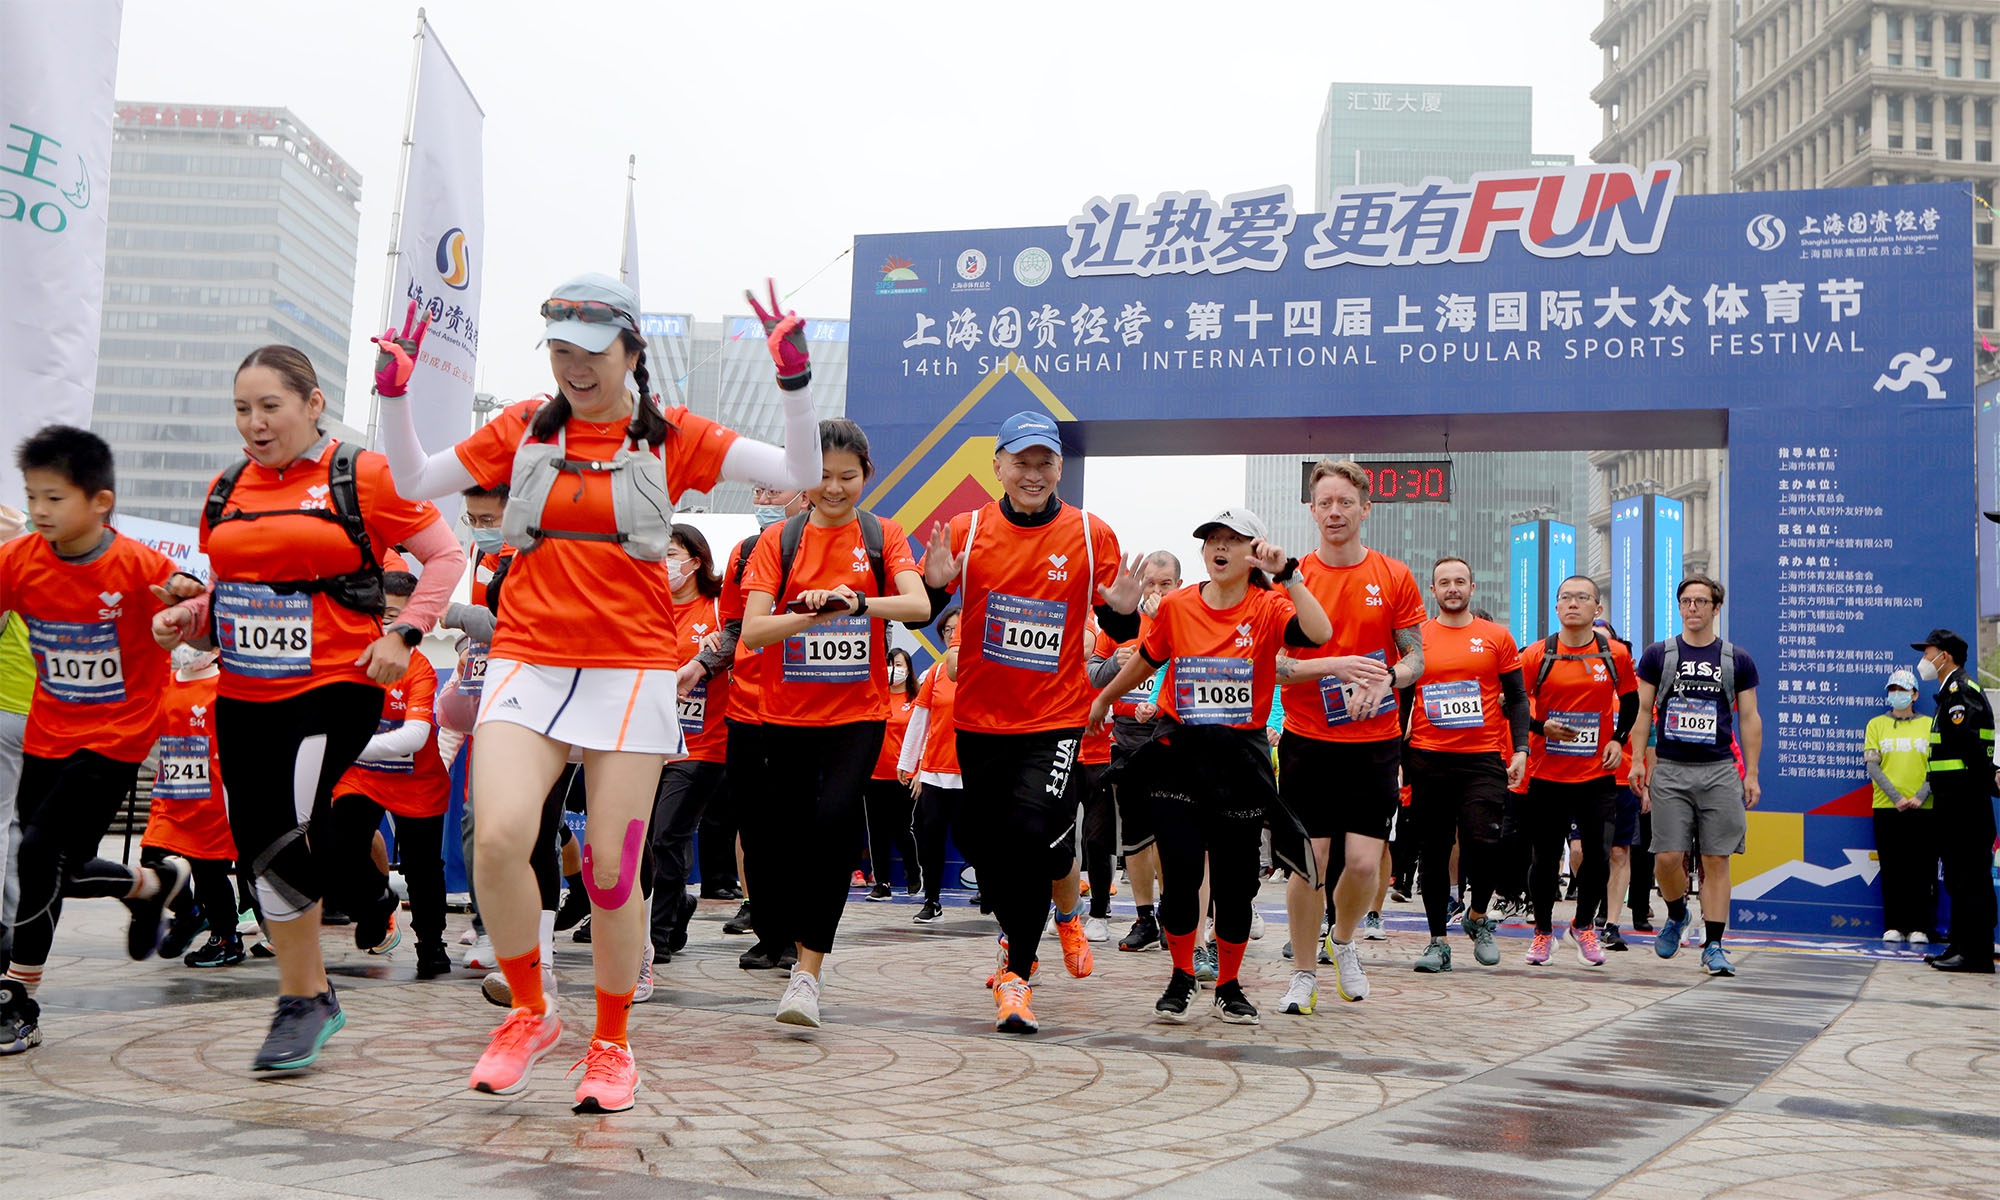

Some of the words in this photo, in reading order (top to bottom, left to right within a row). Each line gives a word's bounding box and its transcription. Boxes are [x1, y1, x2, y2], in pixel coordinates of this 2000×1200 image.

[1348, 92, 1443, 113] 汇亚大厦
[1799, 208, 1941, 236] 上海国资经营
[1072, 193, 1289, 270] 让热爱
[1801, 238, 1830, 247] Shanghai
[1831, 236, 1872, 246] State-owned
[1873, 234, 1894, 243] Assets
[1895, 233, 1939, 242] Management
[1800, 246, 1938, 260] 上海国际集团成员企业之一
[902, 358, 958, 376] 14th
[978, 352, 1122, 375] SHANGHAI
[1143, 344, 1377, 371] INTERNATIONAL
[1400, 341, 1541, 363] POPULAR
[1565, 335, 1685, 359] SPORTS
[1711, 331, 1864, 355] FESTIVAL
[1779, 461, 1835, 471] 上海市体育局
[1779, 493, 1845, 503] 上海市体育总会
[300, 500, 327, 510] SH
[1779, 506, 1883, 516] 上海市人民对外友好协会
[1779, 538, 1893, 549] 上海国有资产经营有限公司
[852, 561, 870, 573] SH
[1048, 570, 1068, 581] SH
[1779, 571, 1874, 581] 上海市体育发展基金会
[1779, 583, 1883, 594] 上海市浦东新区体育总会
[1365, 597, 1383, 606] SH
[1779, 596, 1923, 607] 上海东方明珠广播电视塔有限公司
[98, 607, 123, 620] SH
[1779, 623, 1845, 633] 上海市跳绳协会
[238, 626, 308, 651] 1048
[1006, 627, 1060, 651] 1004
[1235, 637, 1254, 648] SH
[1778, 636, 1817, 646] 和平精英
[808, 640, 867, 661] 1093
[51, 658, 118, 680] 1070
[1593, 674, 1608, 682] SH
[1197, 686, 1251, 704] 1086
[1443, 700, 1481, 715] 1081
[1680, 716, 1715, 730] 1087
